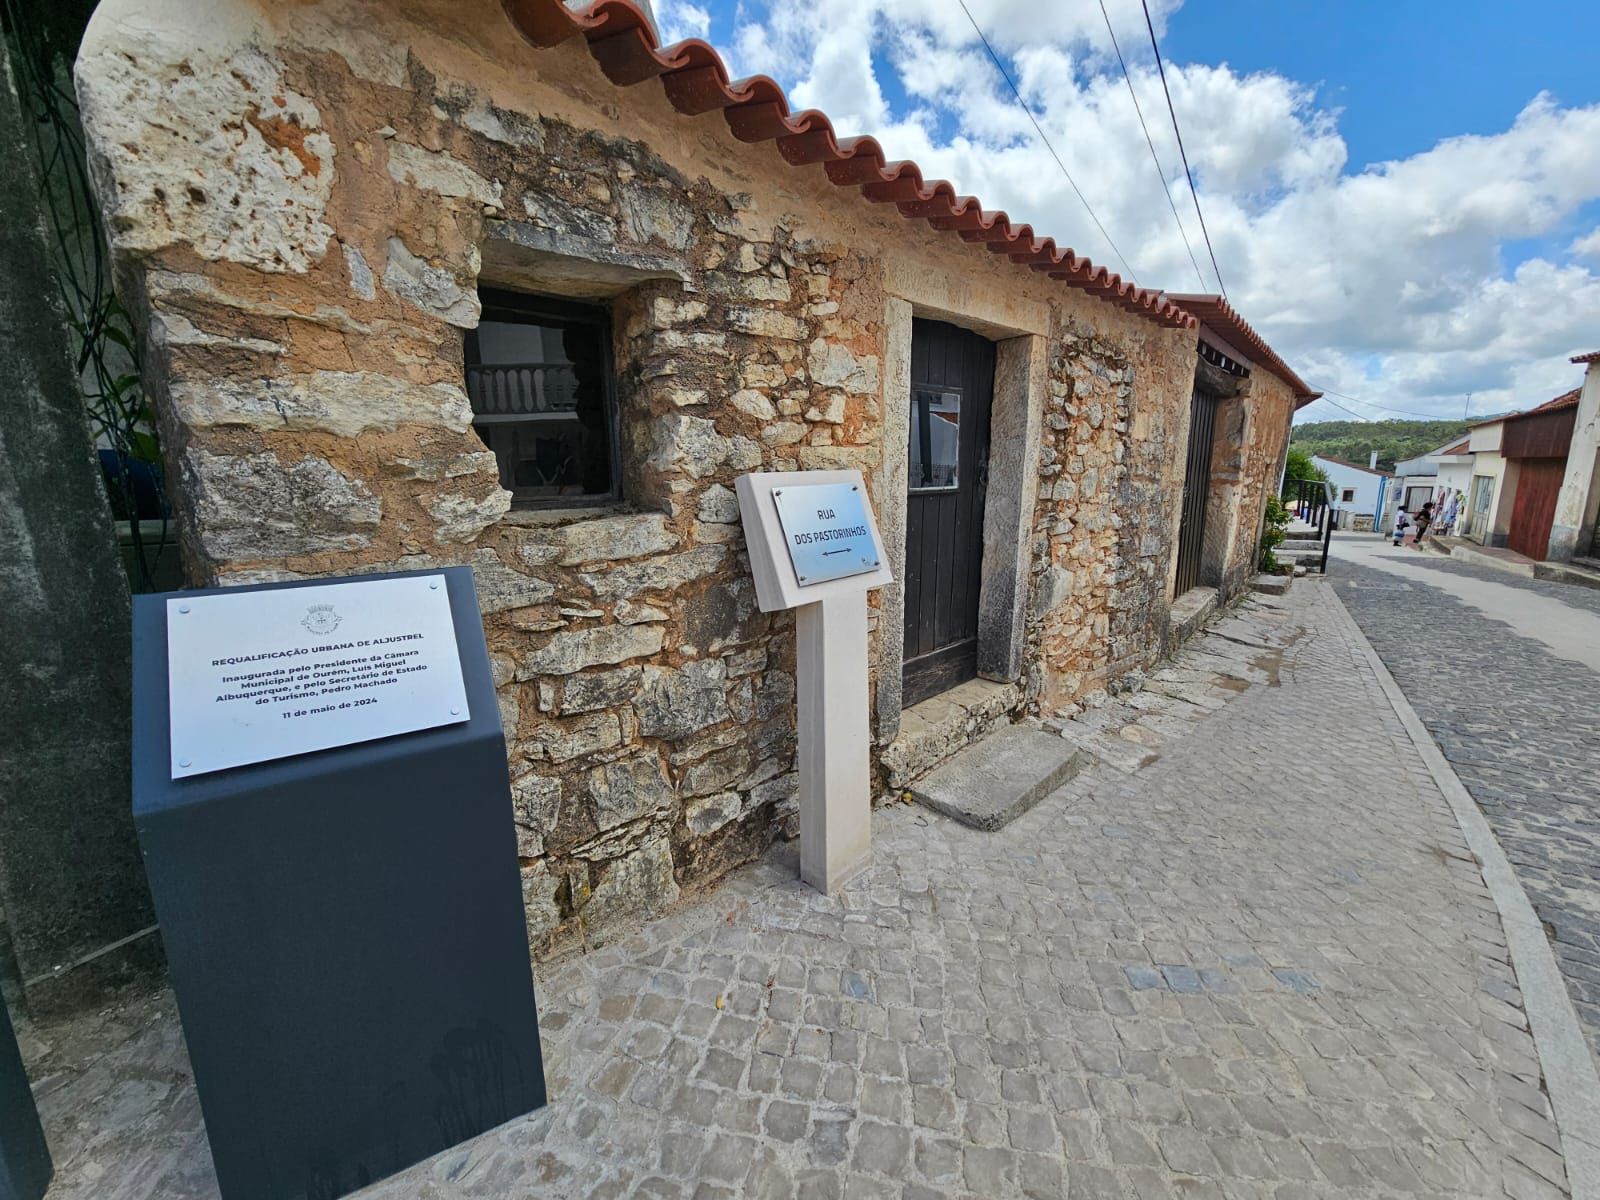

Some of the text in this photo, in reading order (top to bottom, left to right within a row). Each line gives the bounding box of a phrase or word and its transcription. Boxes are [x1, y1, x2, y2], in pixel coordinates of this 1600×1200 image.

[817, 509, 836, 520] RUA
[794, 526, 867, 545] DOS PASTORINHOS
[212, 648, 309, 666] REQUALIFICAÇÃO
[312, 642, 354, 653] URBANA
[373, 633, 424, 645] ALJUSTREL
[222, 669, 286, 683] Inaugurada
[288, 665, 311, 675] pelo
[313, 658, 367, 670] Presidente
[384, 650, 419, 660] Câmara
[241, 676, 294, 690] Municipal
[313, 669, 350, 678] Ourém,
[374, 659, 406, 669] Miguel
[215, 686, 292, 702] Albuquerque,
[303, 681, 326, 691] pelo
[328, 672, 379, 685] Secretário
[396, 664, 428, 674] Estado
[272, 690, 319, 703] Turismo,
[321, 684, 351, 695] Pedro
[354, 677, 398, 690] Machado
[282, 711, 291, 719] 11
[310, 704, 336, 715] maio
[354, 697, 378, 707] 2024
